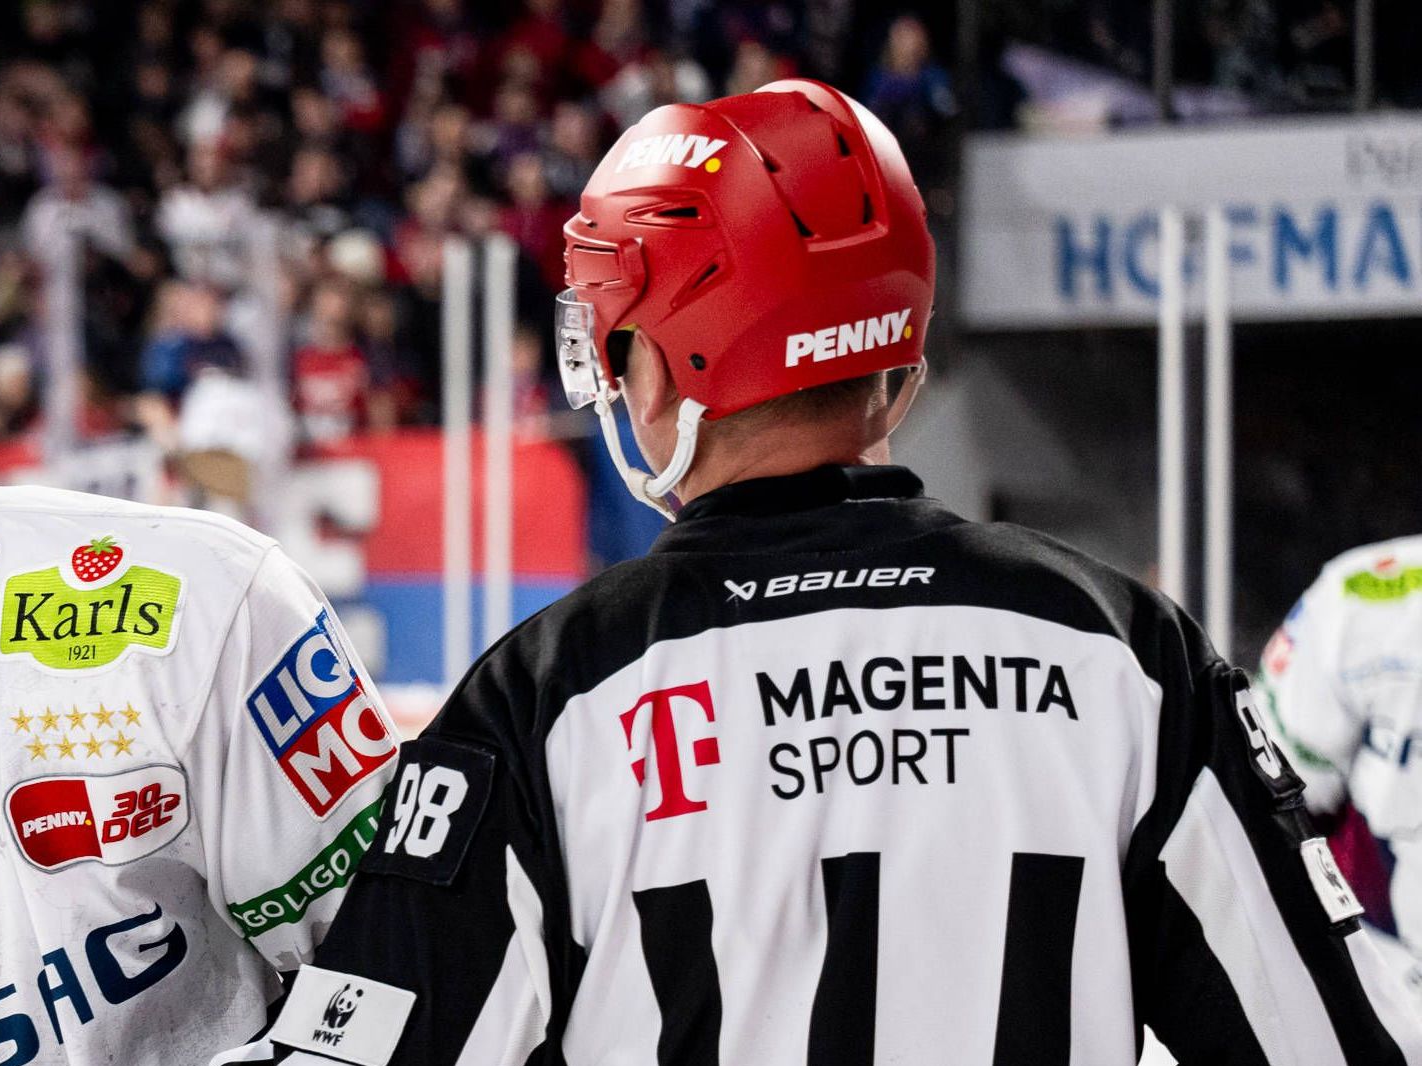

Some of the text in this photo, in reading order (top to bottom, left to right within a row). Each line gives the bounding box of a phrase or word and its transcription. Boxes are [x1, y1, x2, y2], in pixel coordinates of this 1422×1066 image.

[9, 584, 163, 643] Karls
[67, 644, 98, 662] 1921
[755, 655, 1078, 727] MAGENTA
[768, 728, 970, 800] SPORT
[101, 802, 173, 845] DEL
[384, 762, 468, 858] 98
[284, 848, 351, 912] LIGO
[313, 1029, 345, 1047] WWF
